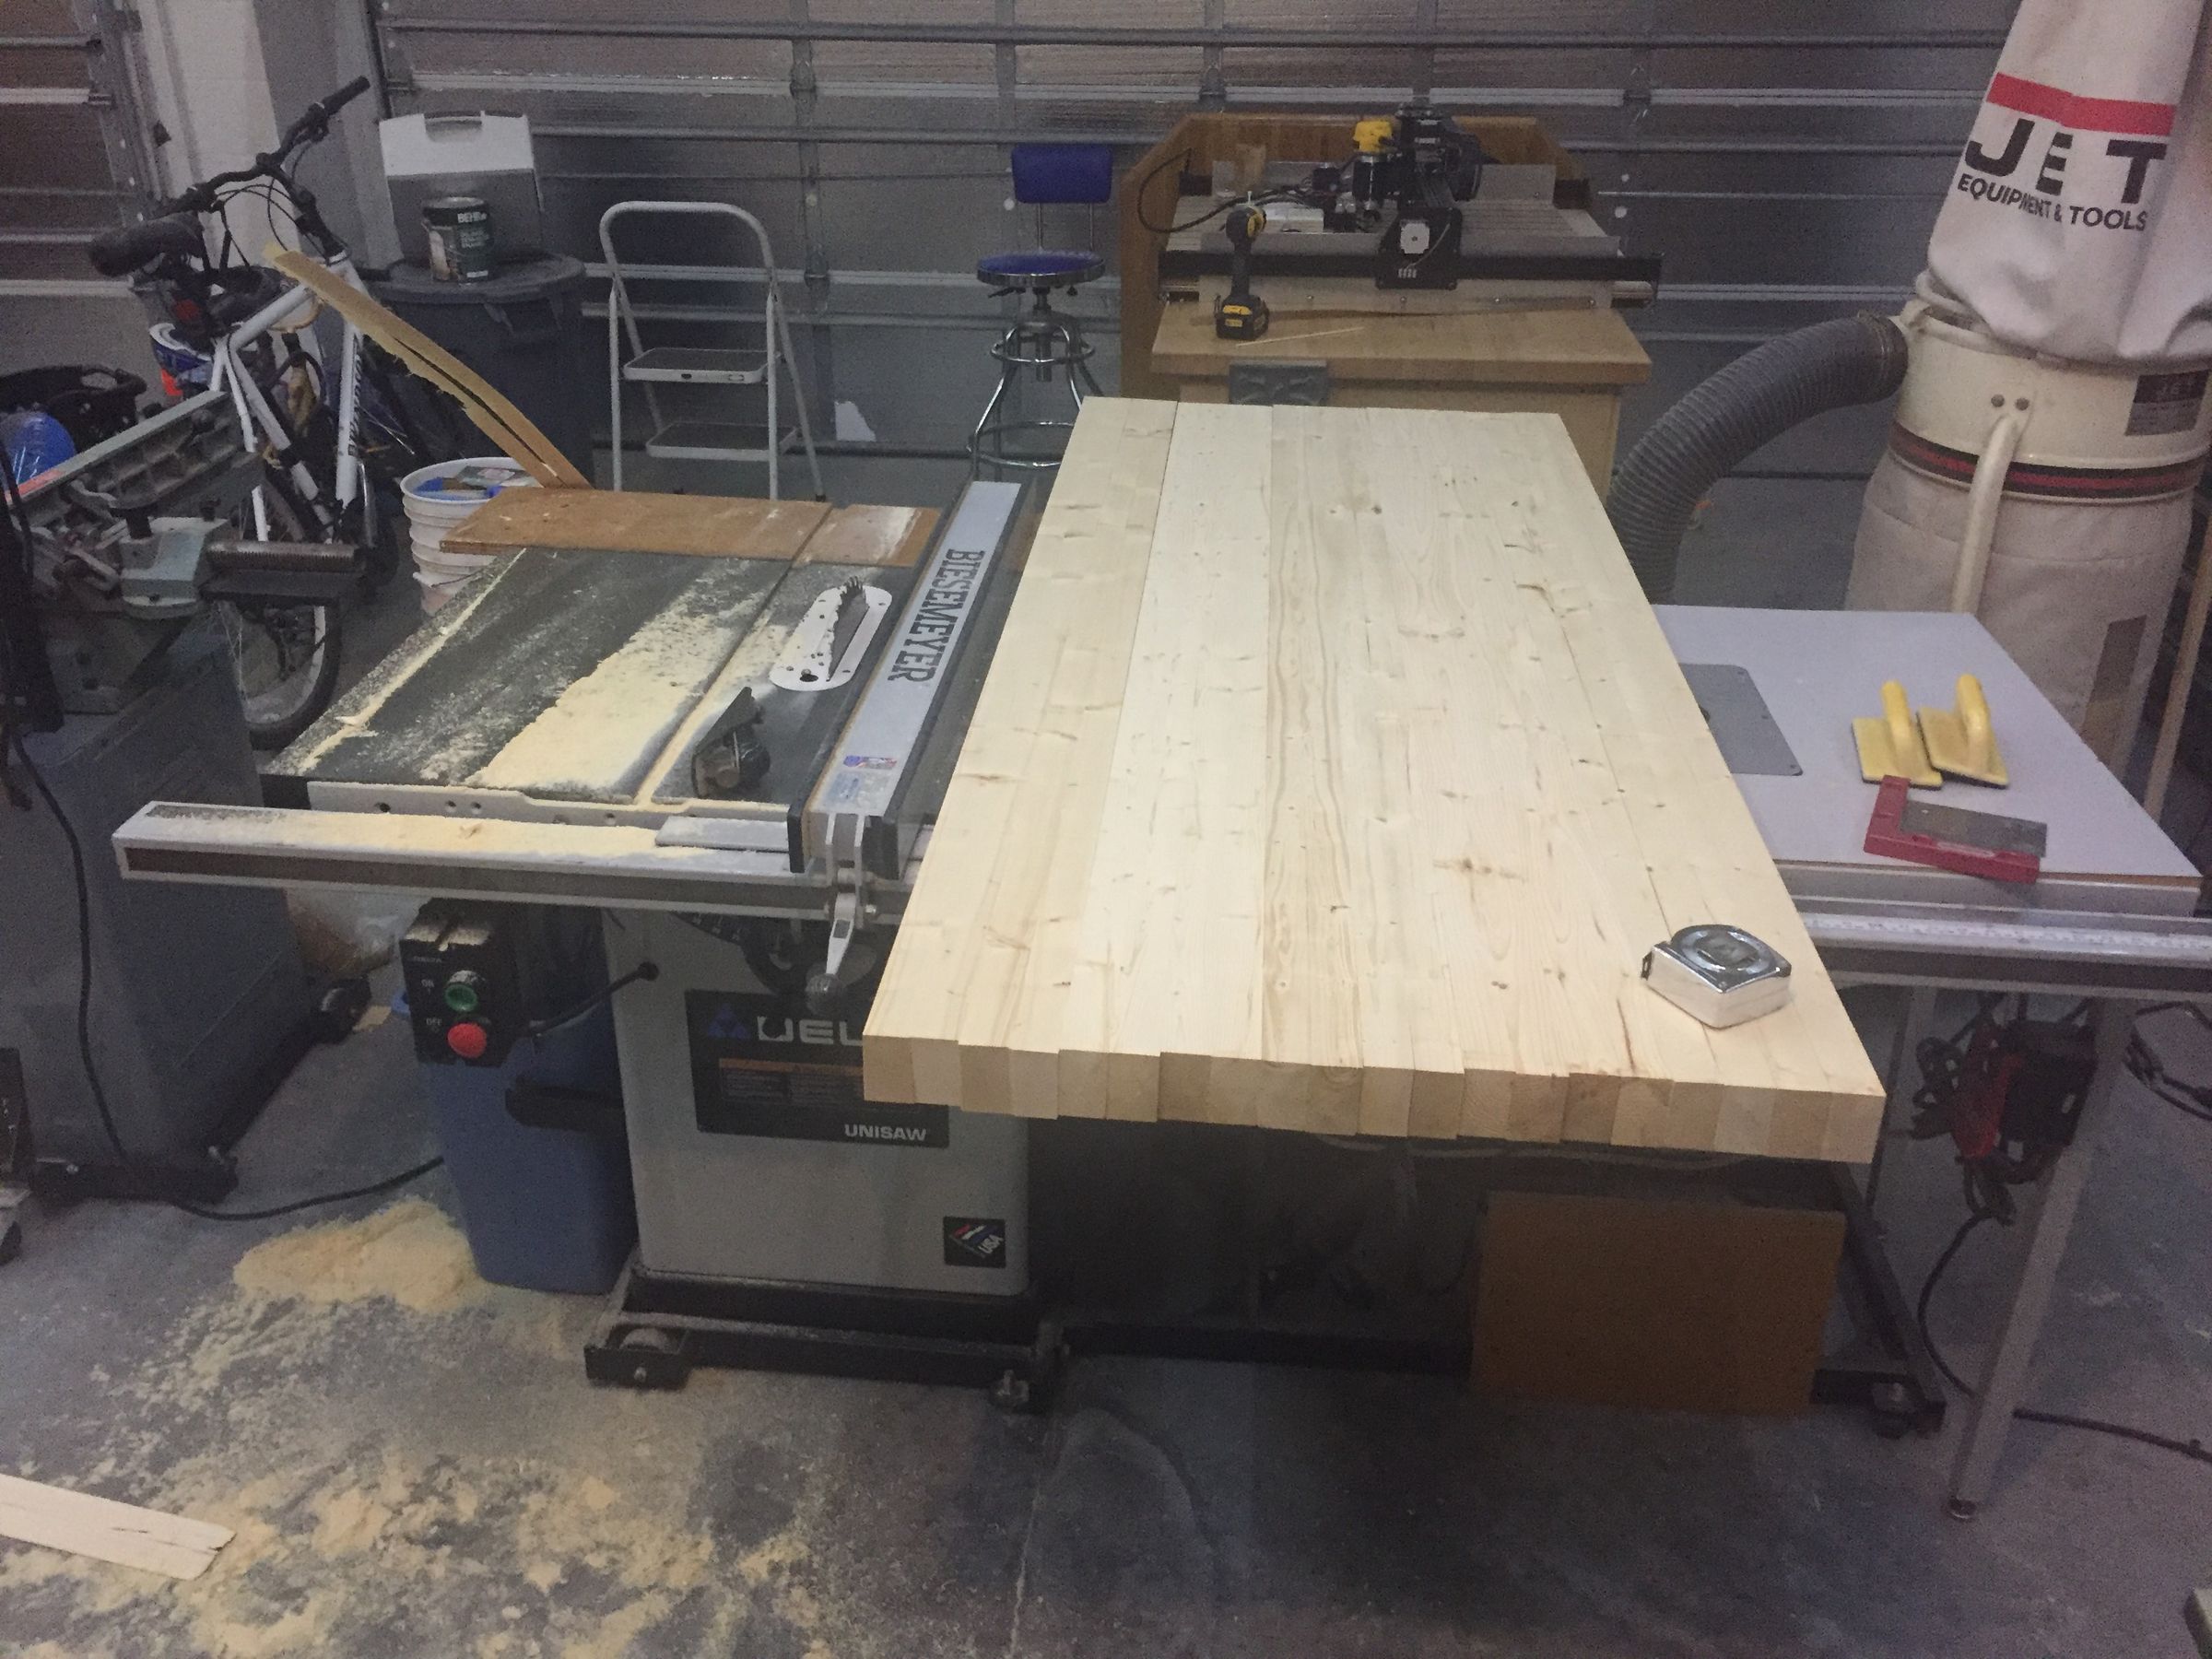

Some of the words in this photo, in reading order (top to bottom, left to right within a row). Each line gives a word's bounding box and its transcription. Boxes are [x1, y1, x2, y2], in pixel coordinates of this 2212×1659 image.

[1964, 118, 2167, 204] JET
[1957, 173, 2052, 218] EQUIPMENT
[2054, 203, 2063, 222] &
[2069, 205, 2148, 232] TOOLS
[887, 548, 985, 682] BIESEMEYER
[757, 1016, 864, 1046] DEL
[843, 1124, 927, 1142] UNISAW
[977, 1234, 1004, 1254] USA
